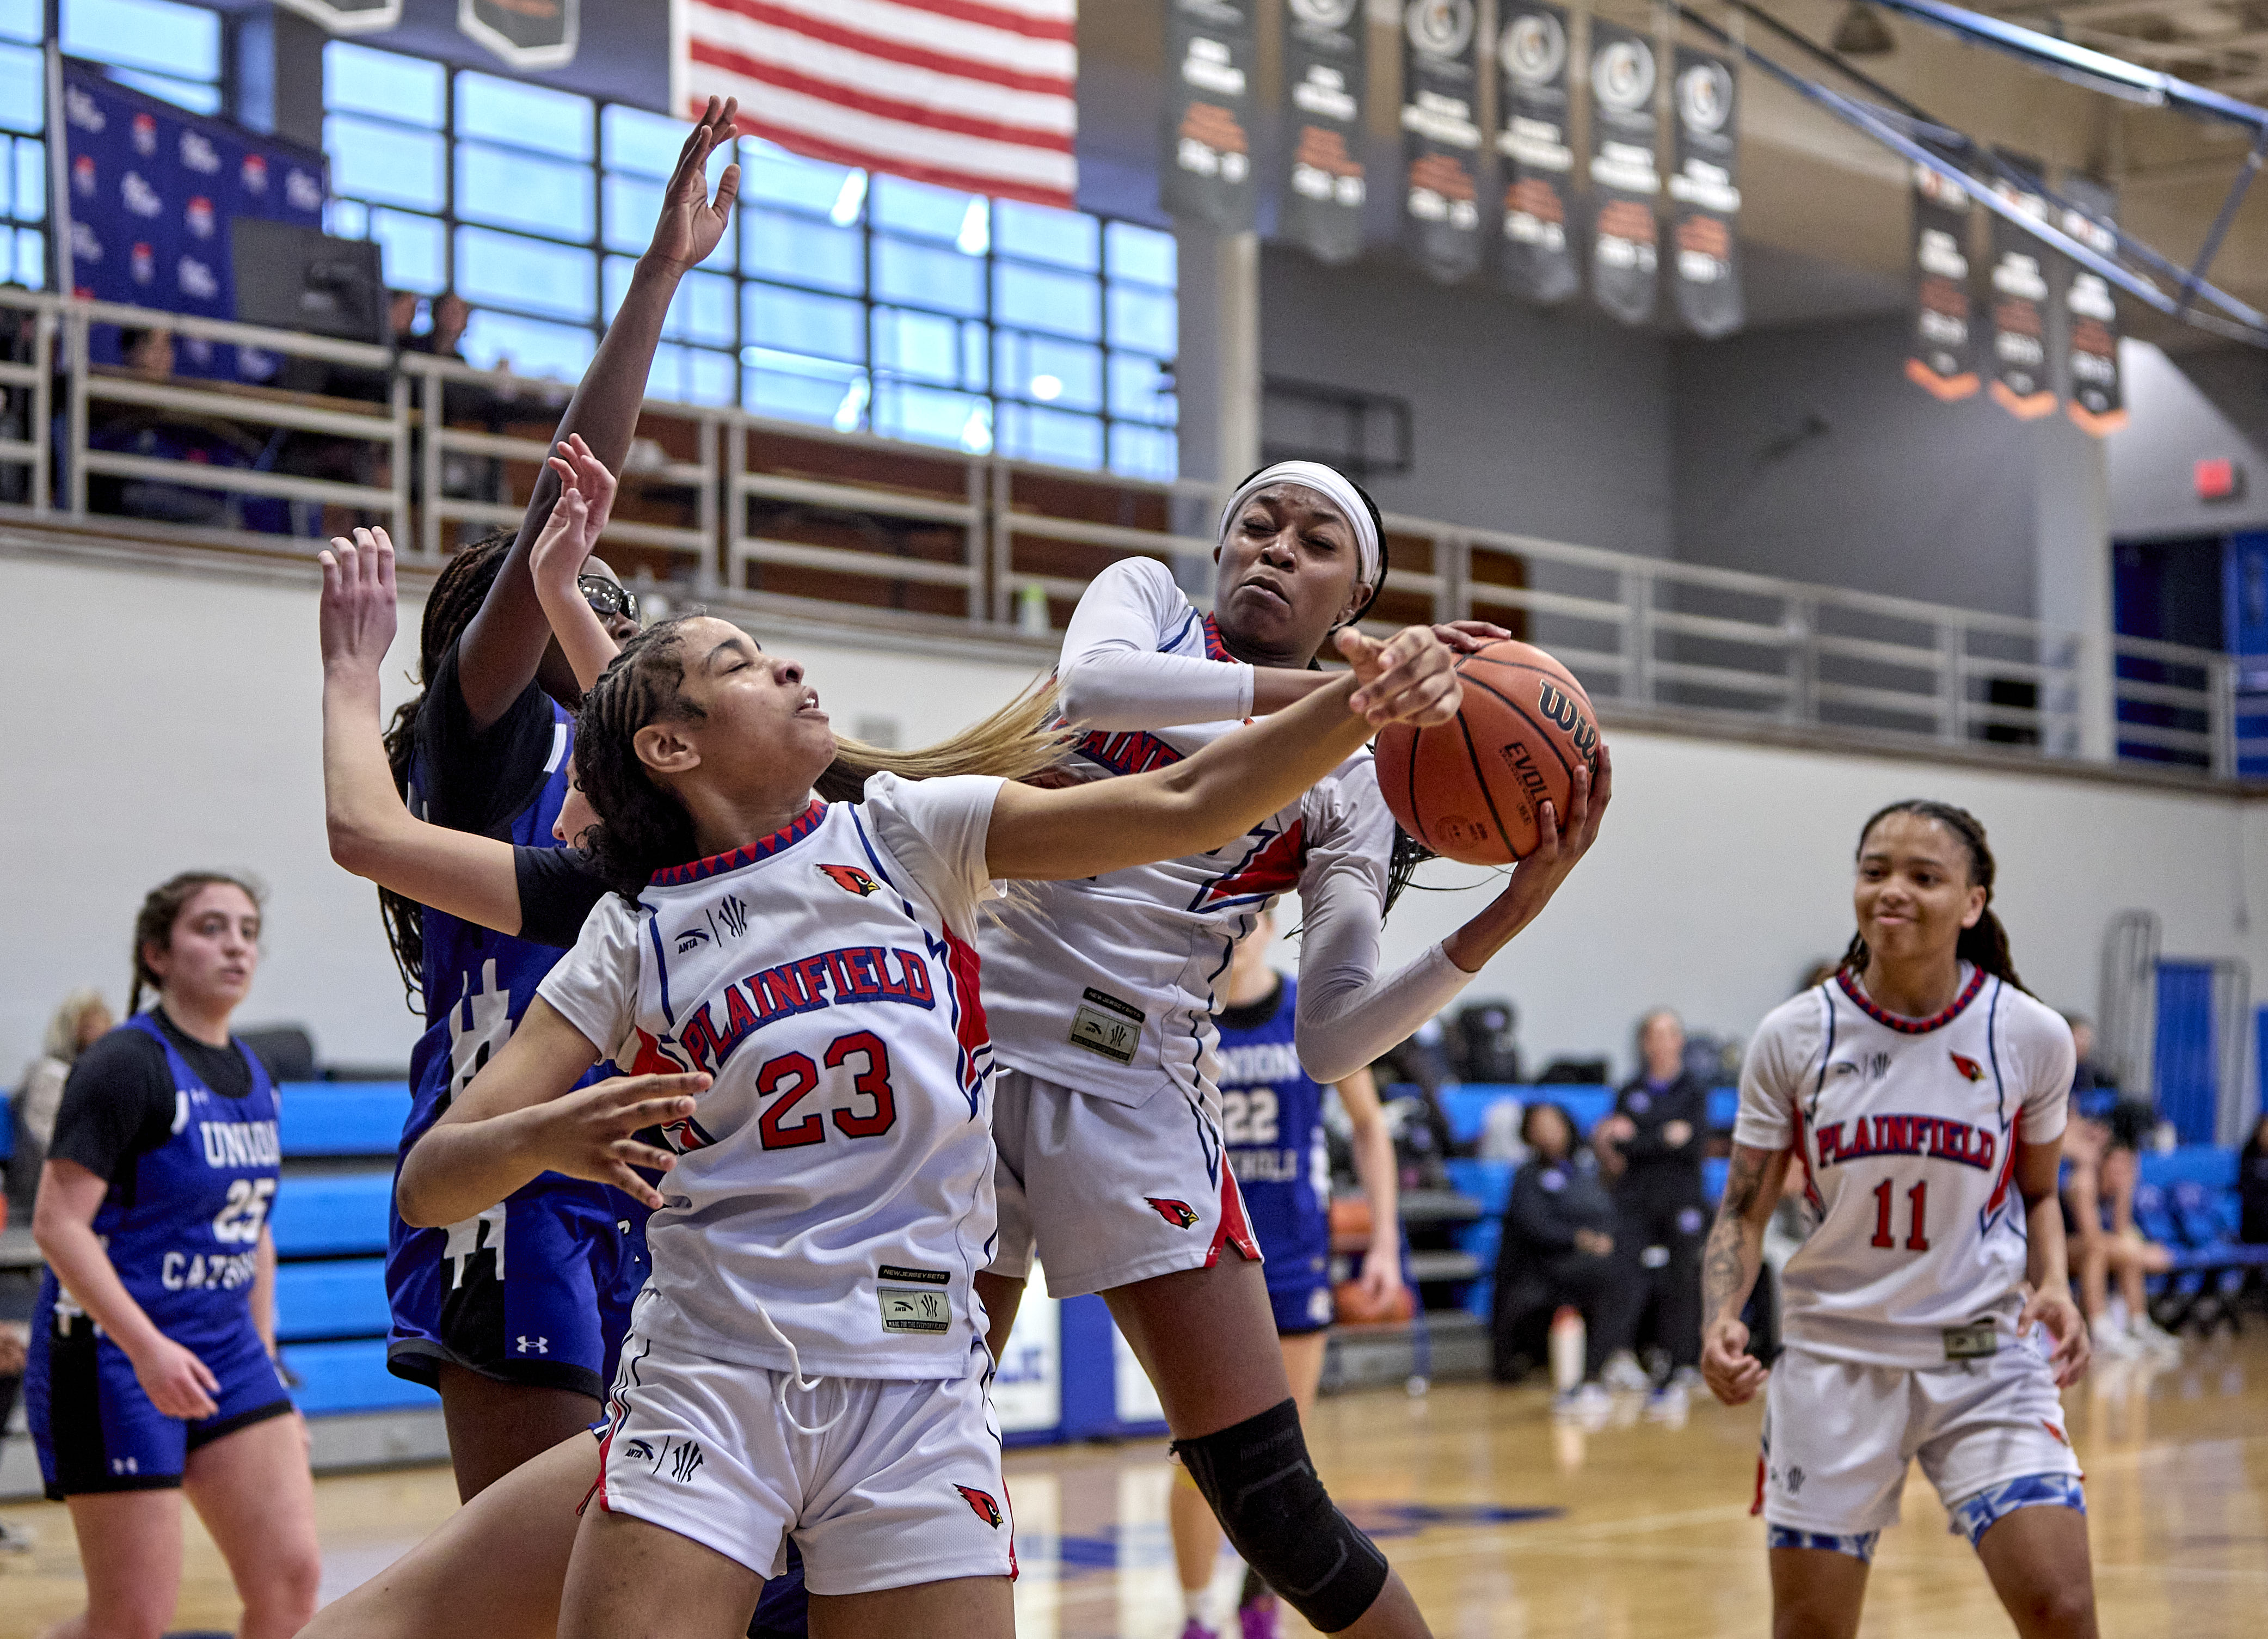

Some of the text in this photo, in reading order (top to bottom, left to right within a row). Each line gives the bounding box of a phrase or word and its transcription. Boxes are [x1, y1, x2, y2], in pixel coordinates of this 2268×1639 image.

[679, 938, 698, 954] ANTA
[680, 946, 936, 1078] PLAINFIELD
[755, 1030, 896, 1150] 23
[1216, 1041, 1301, 1085] NION
[1224, 1088, 1278, 1144] 22
[1816, 1110, 1996, 1172] PLAINFIELD
[212, 1178, 276, 1244] 25
[1871, 1178, 1929, 1251] 11
[883, 1268, 901, 1276] NEW
[625, 1448, 643, 1459] ANTA
